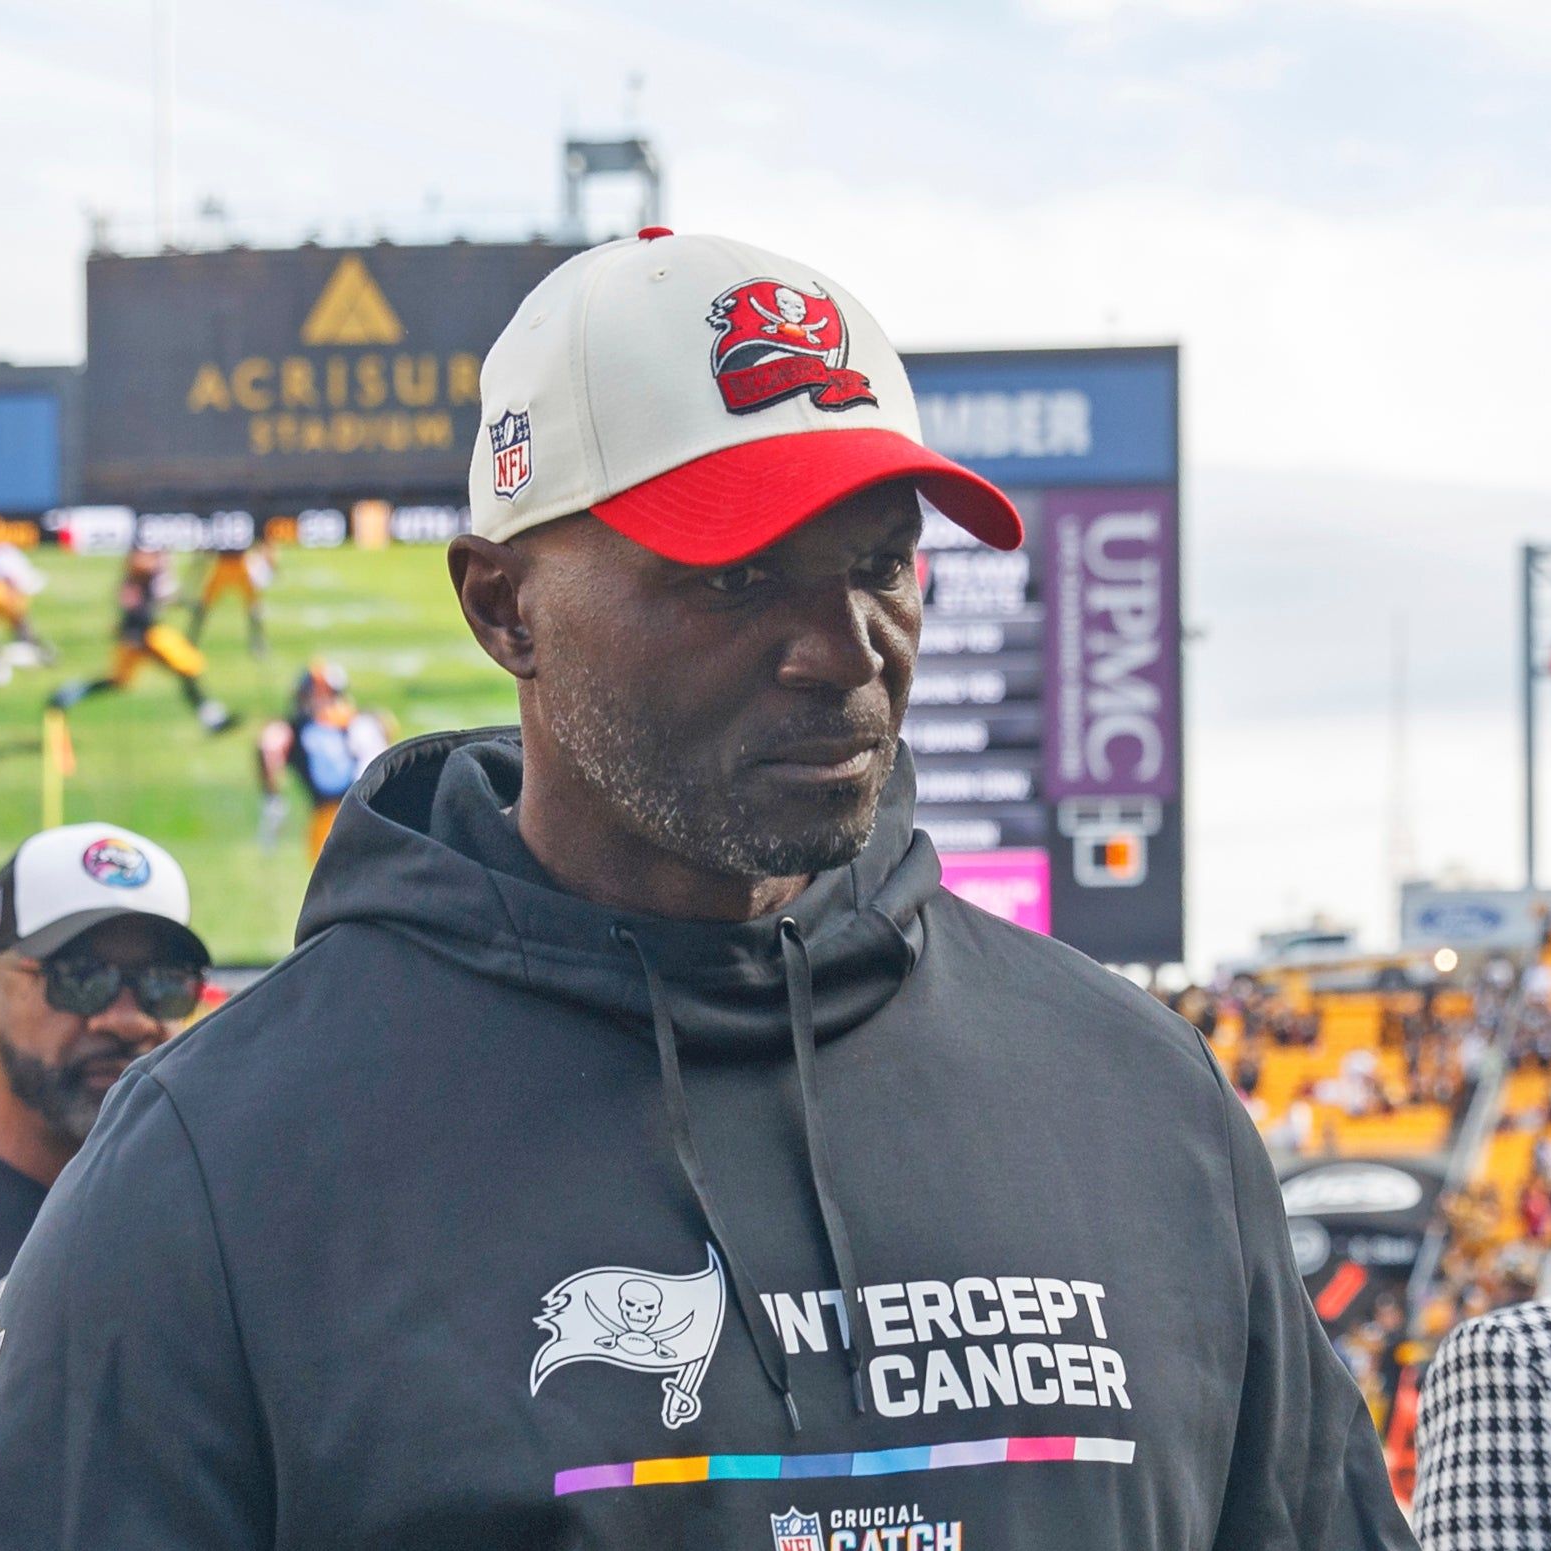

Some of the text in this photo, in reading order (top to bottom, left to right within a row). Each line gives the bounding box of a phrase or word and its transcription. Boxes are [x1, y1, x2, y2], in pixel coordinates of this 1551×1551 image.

[250, 411, 454, 455] STADIUM
[496, 445, 528, 488] NFL
[1082, 509, 1165, 783] UPMC
[867, 1342, 1133, 1418] CANCER
[830, 1503, 924, 1529] CRUCIAL
